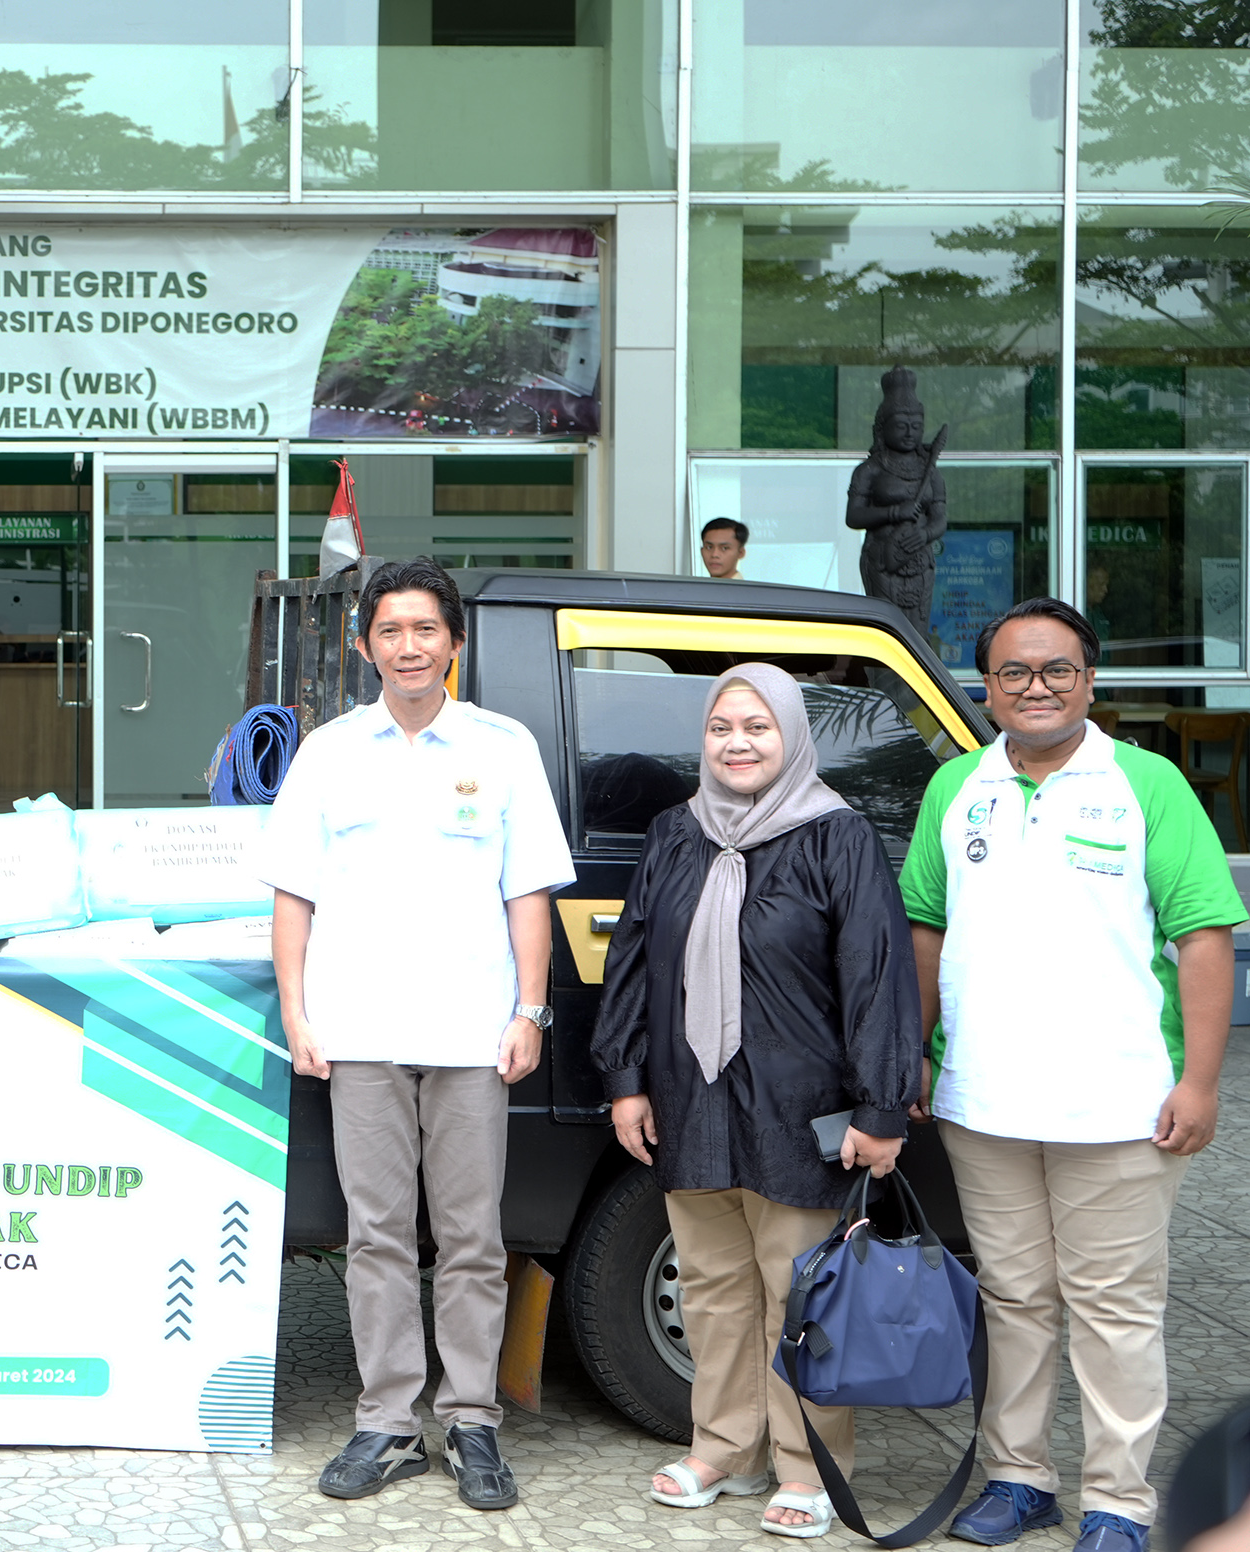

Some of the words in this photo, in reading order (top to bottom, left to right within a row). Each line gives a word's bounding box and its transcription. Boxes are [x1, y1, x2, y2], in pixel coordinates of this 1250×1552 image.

[102, 312, 298, 333] DIPONEGORO
[60, 367, 156, 400] (WBK)
[147, 402, 269, 435] (WBBM)
[1030, 526, 1048, 542] IK
[1088, 526, 1147, 542] EDICA
[167, 825, 216, 834] DONASI
[3, 1163, 143, 1198] UNDIP
[33, 1368, 77, 1384] 2024
